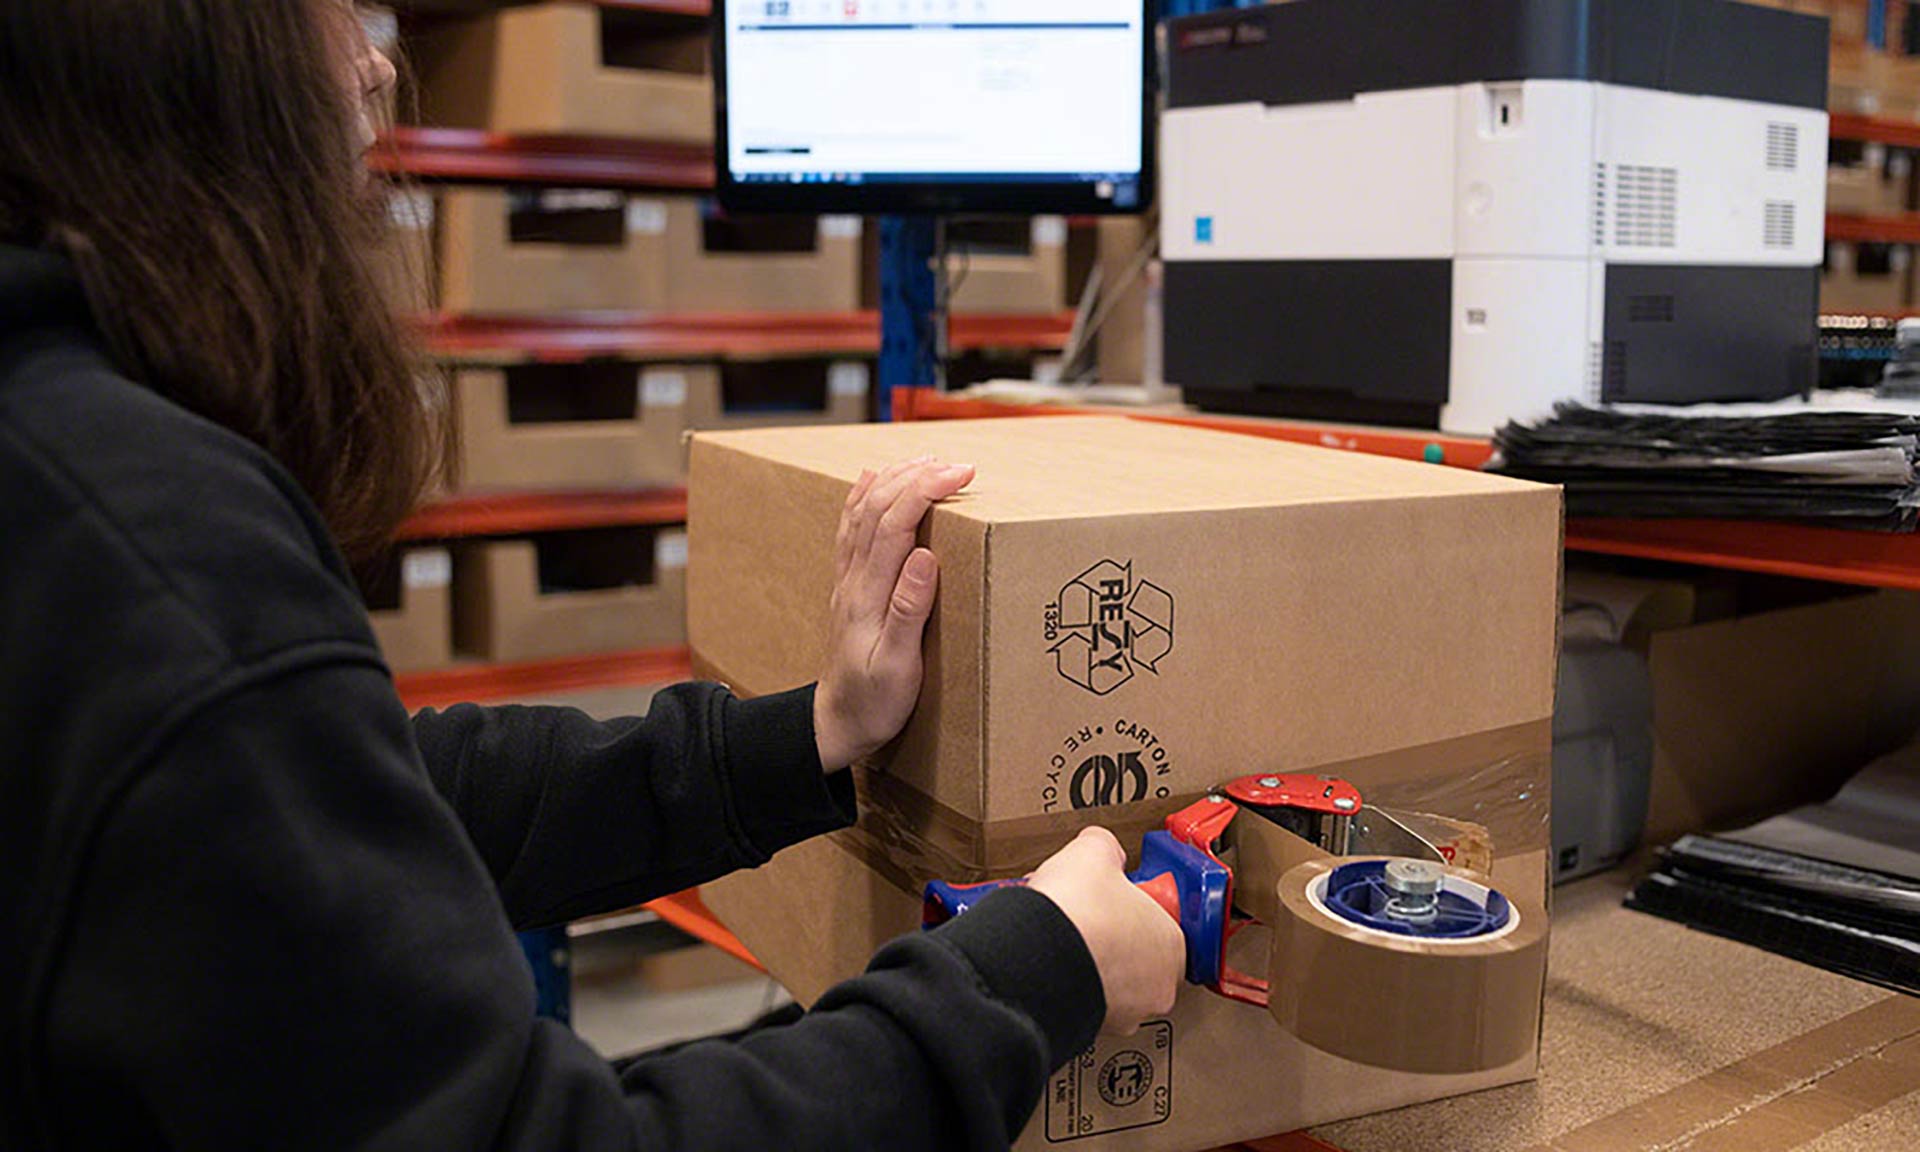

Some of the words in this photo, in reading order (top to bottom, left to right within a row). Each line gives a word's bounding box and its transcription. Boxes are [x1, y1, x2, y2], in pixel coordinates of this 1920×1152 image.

[1044, 601, 1058, 640] 1320
[1092, 579, 1130, 672] RESY
[1115, 719, 1171, 776] CARTON
